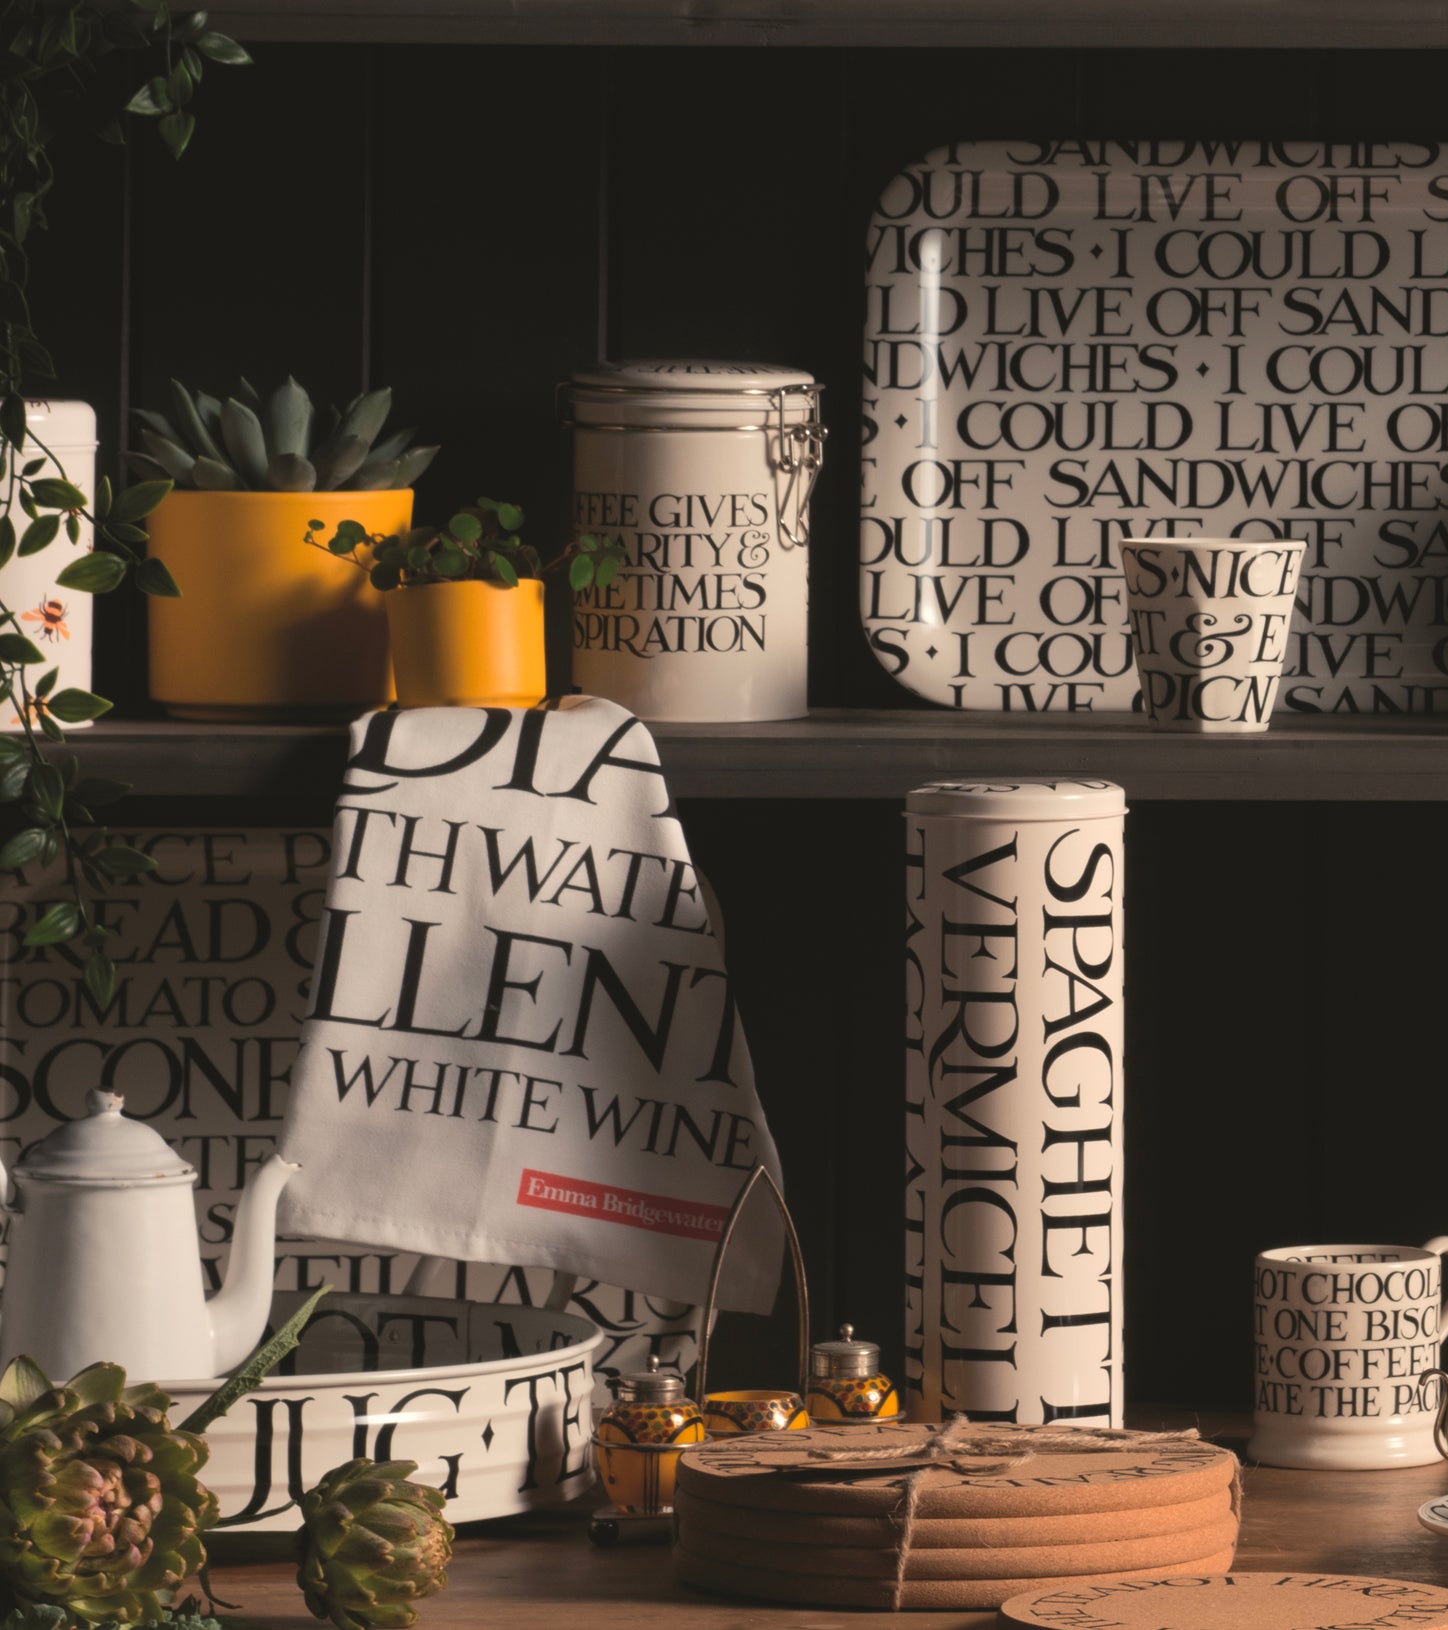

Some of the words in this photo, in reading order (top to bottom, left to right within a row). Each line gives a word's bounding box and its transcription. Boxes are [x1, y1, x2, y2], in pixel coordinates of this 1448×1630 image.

[875, 169, 1059, 220] OULD
[1092, 171, 1243, 223] LIVE
[1275, 174, 1402, 224] OFF
[1110, 228, 1134, 279] I
[1154, 229, 1390, 281] COULD
[866, 285, 968, 337] LD
[982, 285, 1133, 338] LIVE
[1146, 287, 1274, 338] OFF
[1222, 344, 1247, 395] I
[956, 400, 1193, 452] COULD
[1214, 401, 1366, 453] LIVE
[901, 459, 1026, 510] OFF
[649, 493, 769, 529] GIVES
[737, 530, 770, 569] &
[860, 516, 1030, 569] OULD
[866, 570, 1015, 626] LIVE
[1040, 575, 1131, 626] OF
[1175, 550, 1302, 599] NICE
[952, 632, 975, 679] I
[1169, 612, 1252, 669] &
[327, 1047, 563, 1135] WHITE
[526, 1177, 598, 1208] Emma
[602, 1192, 724, 1233] Bridgewater
[1302, 1267, 1441, 1305] CHOCOL
[1274, 1308, 1348, 1342] ONE
[1276, 1343, 1427, 1382] COFFEE
[1258, 1380, 1305, 1416] ATE
[1310, 1384, 1381, 1418] THE
[1031, 1576, 1251, 1605] TEAPOT
[1273, 1577, 1436, 1600] HERE
